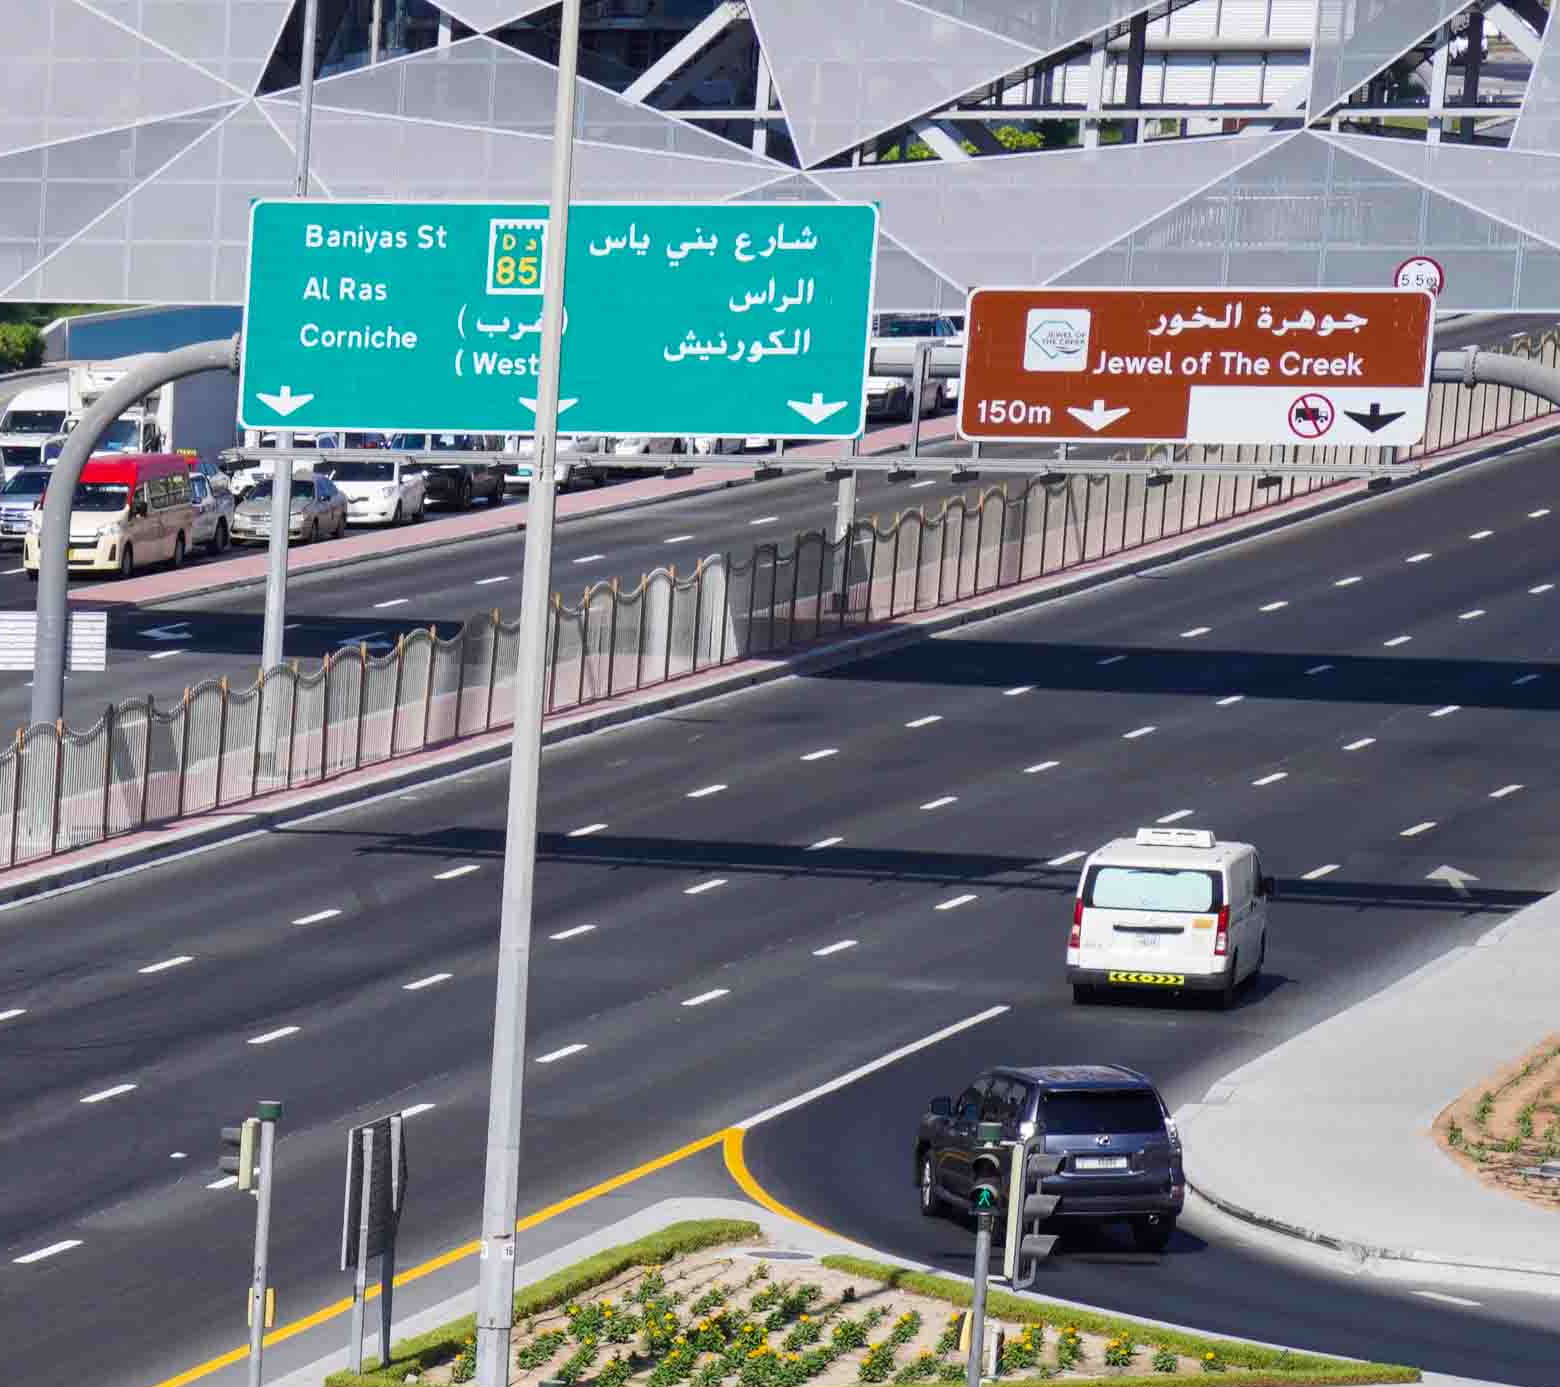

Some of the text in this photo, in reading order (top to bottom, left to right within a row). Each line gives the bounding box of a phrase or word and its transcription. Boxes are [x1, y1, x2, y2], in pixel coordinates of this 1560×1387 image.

[305, 224, 447, 253] Baniyas St
[502, 234, 517, 251] D
[589, 223, 817, 267] شارع بني ياس
[496, 256, 538, 285] 85
[304, 278, 387, 301] Al Ras
[728, 279, 814, 313] الراس
[1147, 301, 1368, 338] جوهرة الخور
[300, 323, 418, 348] Corniche
[663, 328, 811, 363] الكورنيش
[1093, 350, 1364, 377] Jewel of The Creek
[977, 400, 1052, 425] 150m
